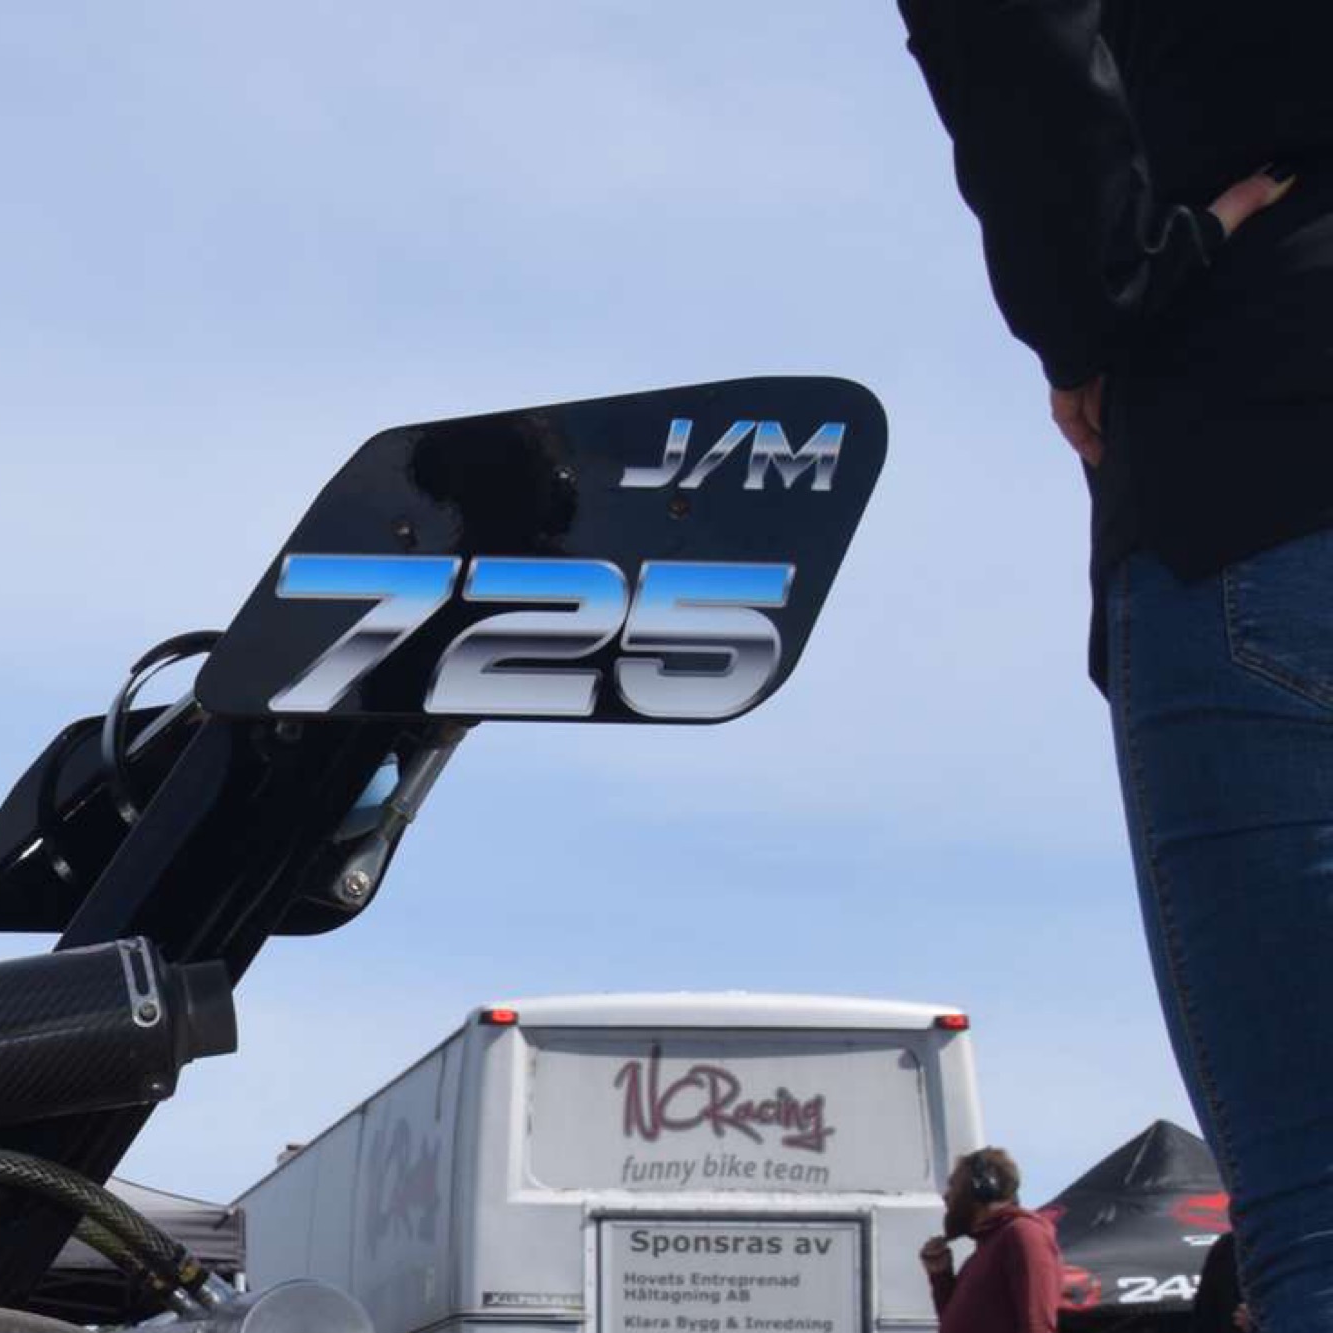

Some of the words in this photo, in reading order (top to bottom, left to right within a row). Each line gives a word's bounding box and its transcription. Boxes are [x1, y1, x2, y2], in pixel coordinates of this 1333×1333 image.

[268, 554, 797, 719] 725
[621, 1155, 696, 1184] funny
[702, 1153, 758, 1178] bike
[763, 1156, 831, 1184] team
[630, 1230, 783, 1257] Sponsras
[794, 1236, 832, 1255] av
[690, 1272, 800, 1288] Entreprenad
[623, 1288, 721, 1304] Håltagning
[726, 1289, 751, 1301] AB
[623, 1316, 670, 1329] Klara
[676, 1316, 720, 1332] Bygg
[726, 1316, 739, 1329] &
[745, 1316, 833, 1333] Inredning
